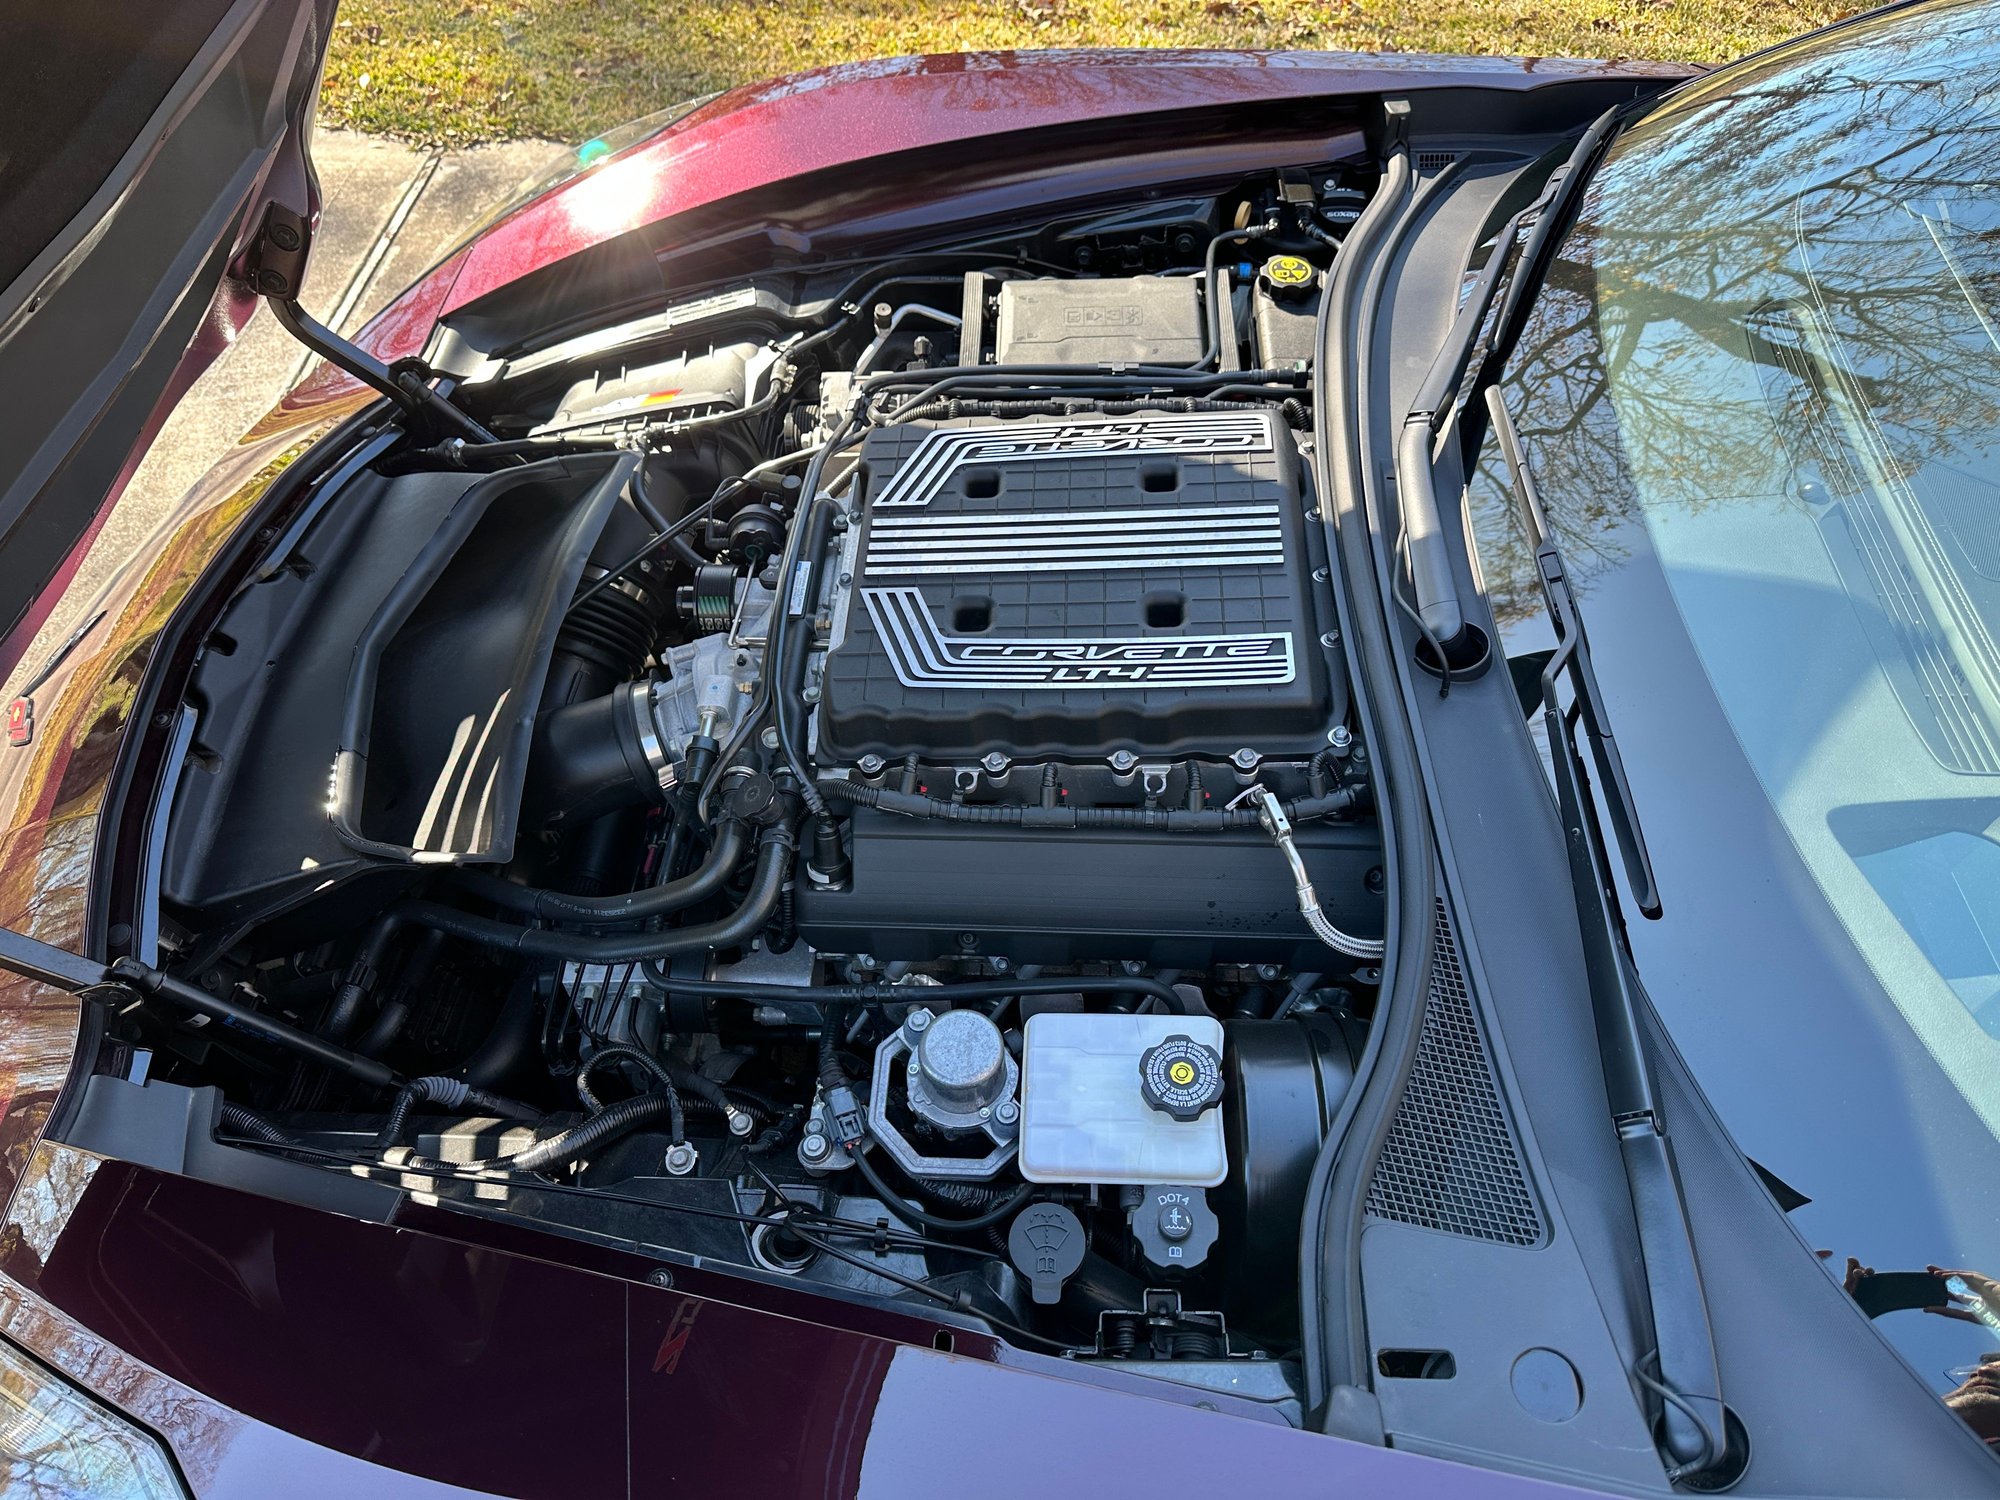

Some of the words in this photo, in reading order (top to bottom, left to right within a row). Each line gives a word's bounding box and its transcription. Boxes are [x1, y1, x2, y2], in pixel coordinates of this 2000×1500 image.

[1326, 211, 1360, 219] dexos
[1059, 424, 1143, 438] LT4
[976, 434, 1252, 457] CORVETTE
[960, 640, 1273, 660] CORVETTE
[1052, 666, 1147, 680] LT4
[1157, 1193, 1190, 1206] DOT4
